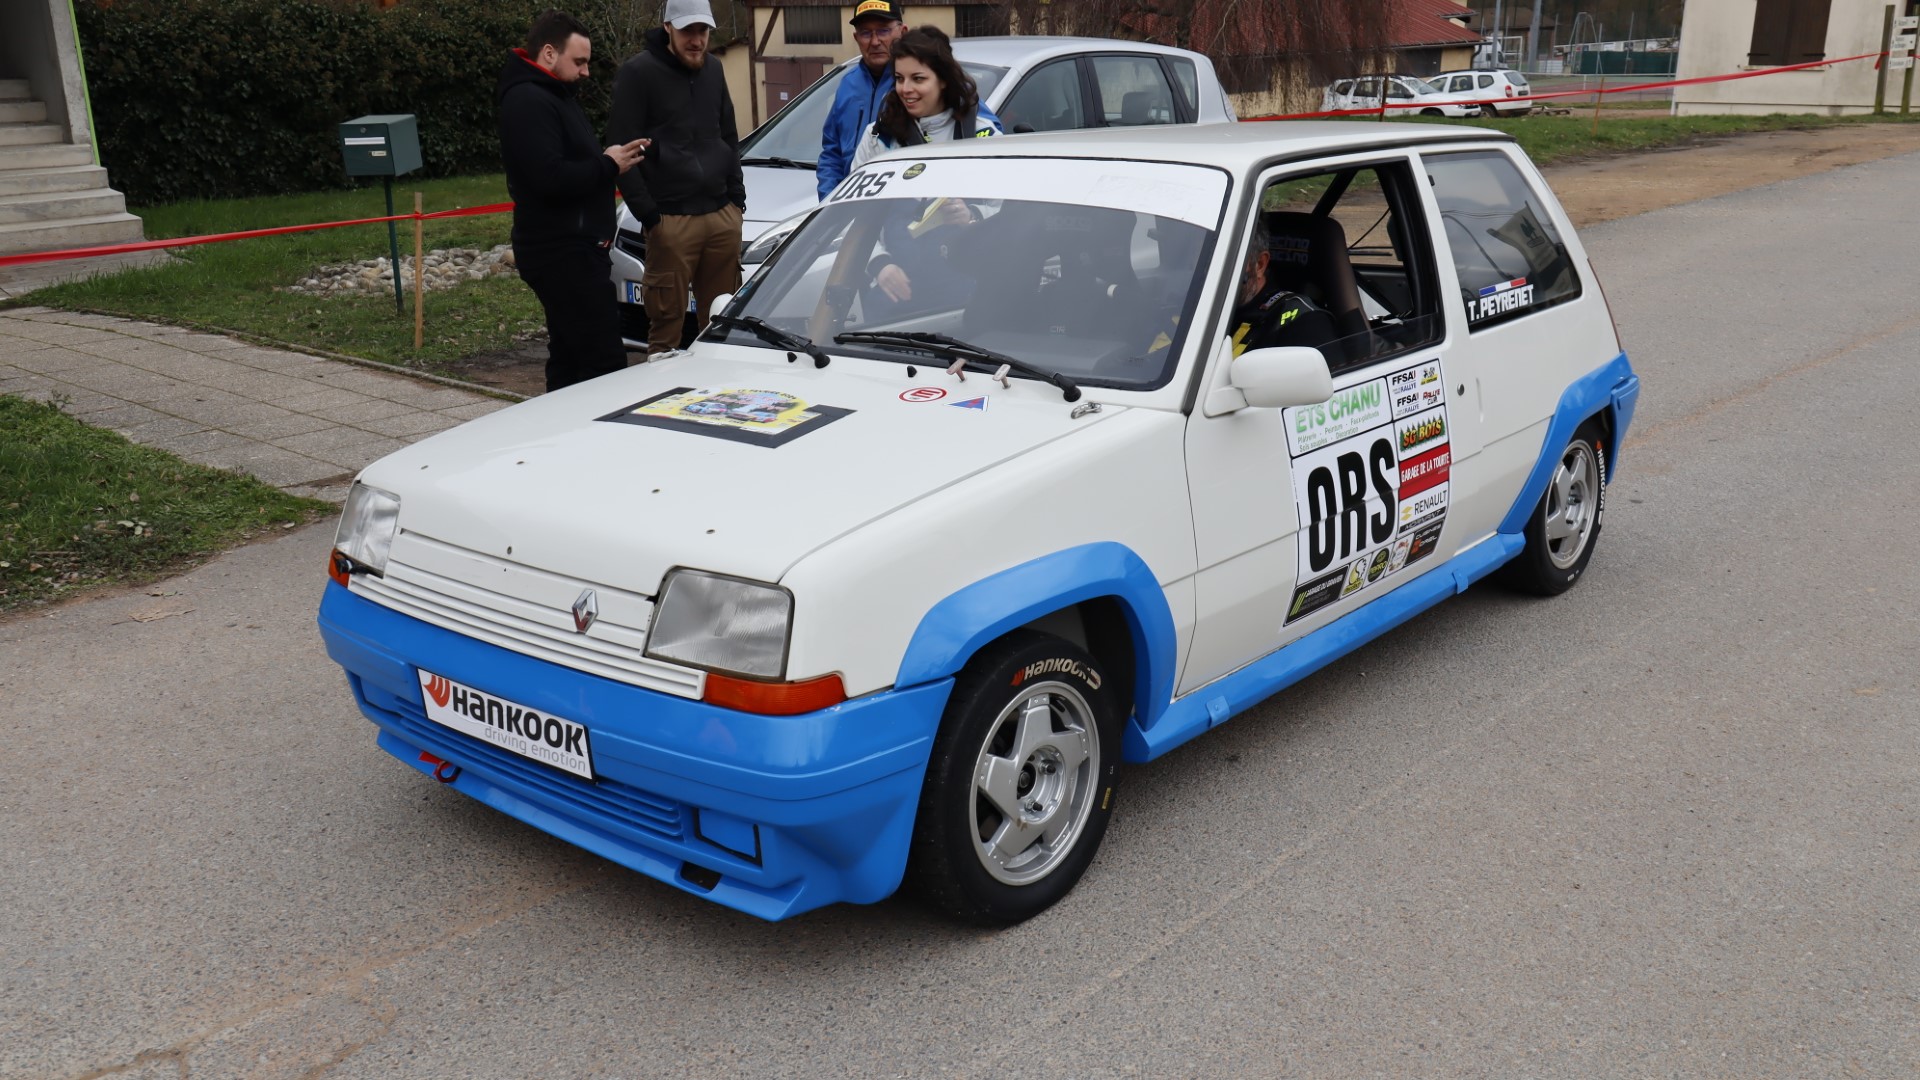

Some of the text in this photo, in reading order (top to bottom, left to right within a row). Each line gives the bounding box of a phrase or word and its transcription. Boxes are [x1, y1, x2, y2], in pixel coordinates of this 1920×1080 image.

[830, 170, 895, 202] ORS
[1468, 284, 1534, 321] T.PEYRENET
[1295, 382, 1381, 433] ETS CHANU
[1403, 419, 1442, 447] SG BOIS
[1401, 464, 1420, 483] GARAGE
[1420, 461, 1427, 475] DE
[1427, 458, 1434, 472] LA
[1307, 437, 1395, 573] ORS
[1415, 490, 1447, 516] RENAULT
[484, 726, 587, 773] driving emotion
